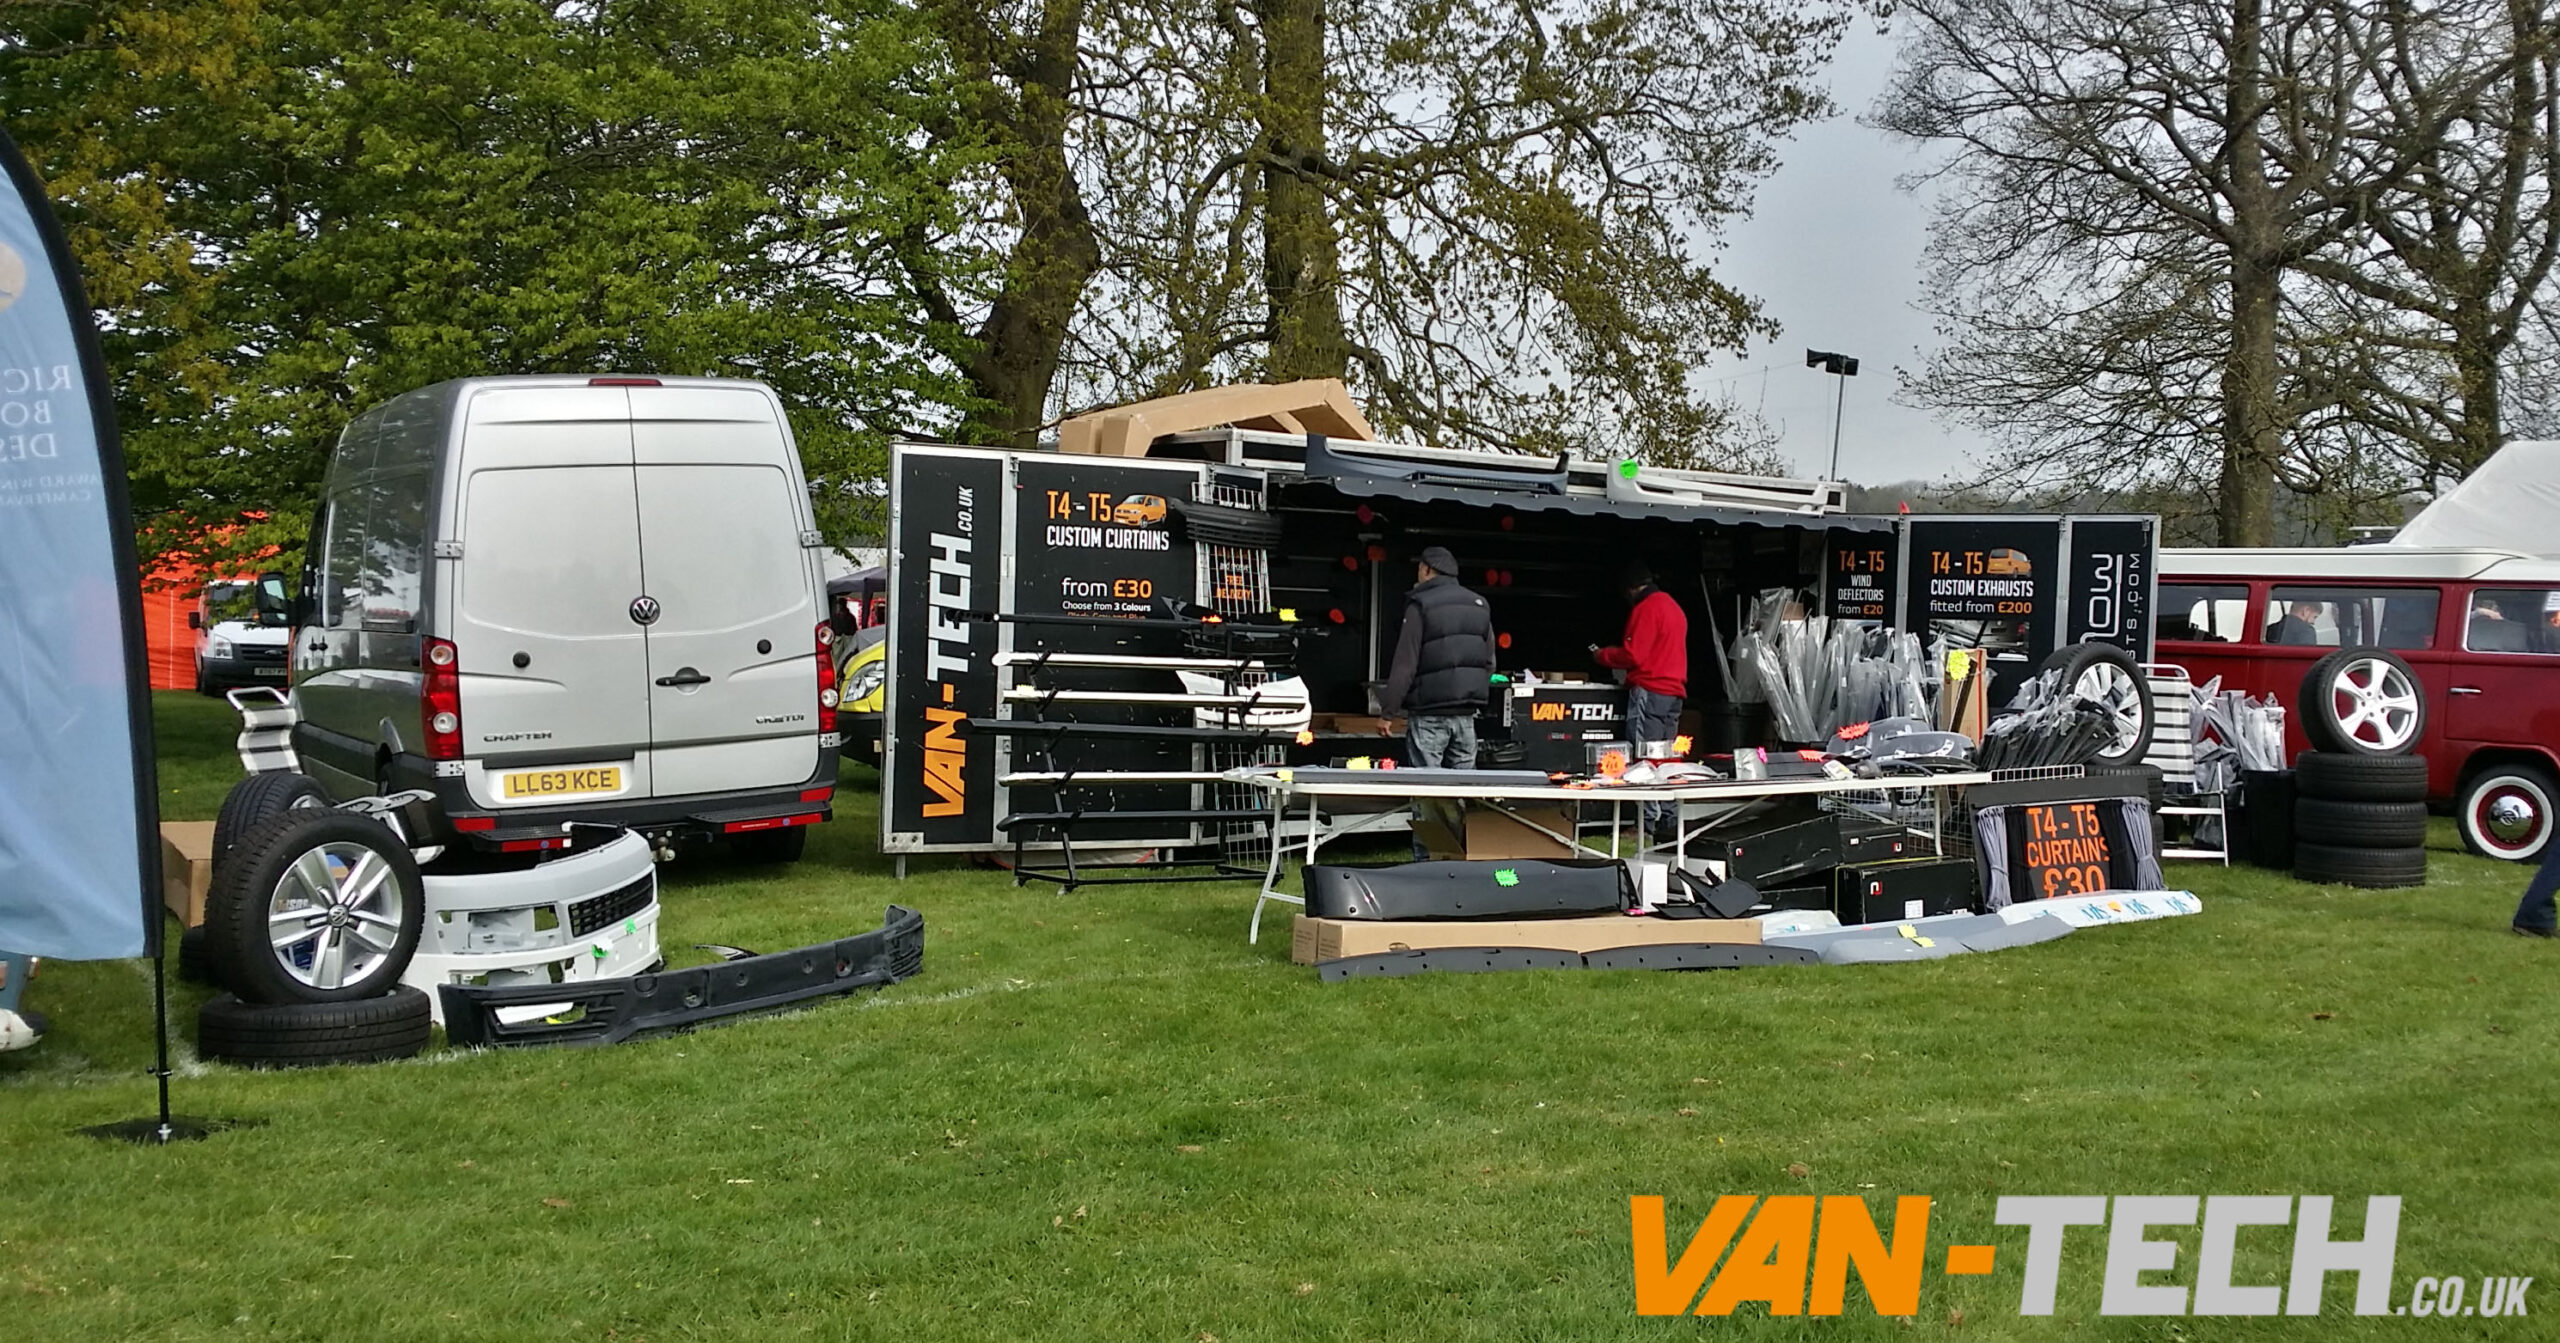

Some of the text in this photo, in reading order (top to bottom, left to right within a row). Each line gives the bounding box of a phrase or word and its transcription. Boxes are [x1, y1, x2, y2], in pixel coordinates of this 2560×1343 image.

[1046, 490, 1071, 519] T4
[1088, 493, 1111, 522] T5
[1046, 525, 1169, 551] CUSTOM CURTAINS
[1839, 550, 1856, 571] T4
[1868, 551, 1885, 572] T5
[1931, 551, 1951, 574] T4
[1964, 551, 1984, 575] T5
[1061, 577, 1152, 599] from £30
[1851, 574, 1872, 587] WIND
[1930, 579, 2034, 597] CUSTOM EXHAUSTS
[1838, 588, 1884, 601] DEFLECTORS
[1062, 600, 1152, 612] Choose from 3 Colours
[1838, 604, 1884, 615] from £20
[1929, 600, 2033, 614] fitted from £200
[513, 770, 613, 794] LL63 KCE
[2027, 806, 2057, 839] T4
[2071, 804, 2100, 837] T5
[2044, 865, 2106, 899] £30
